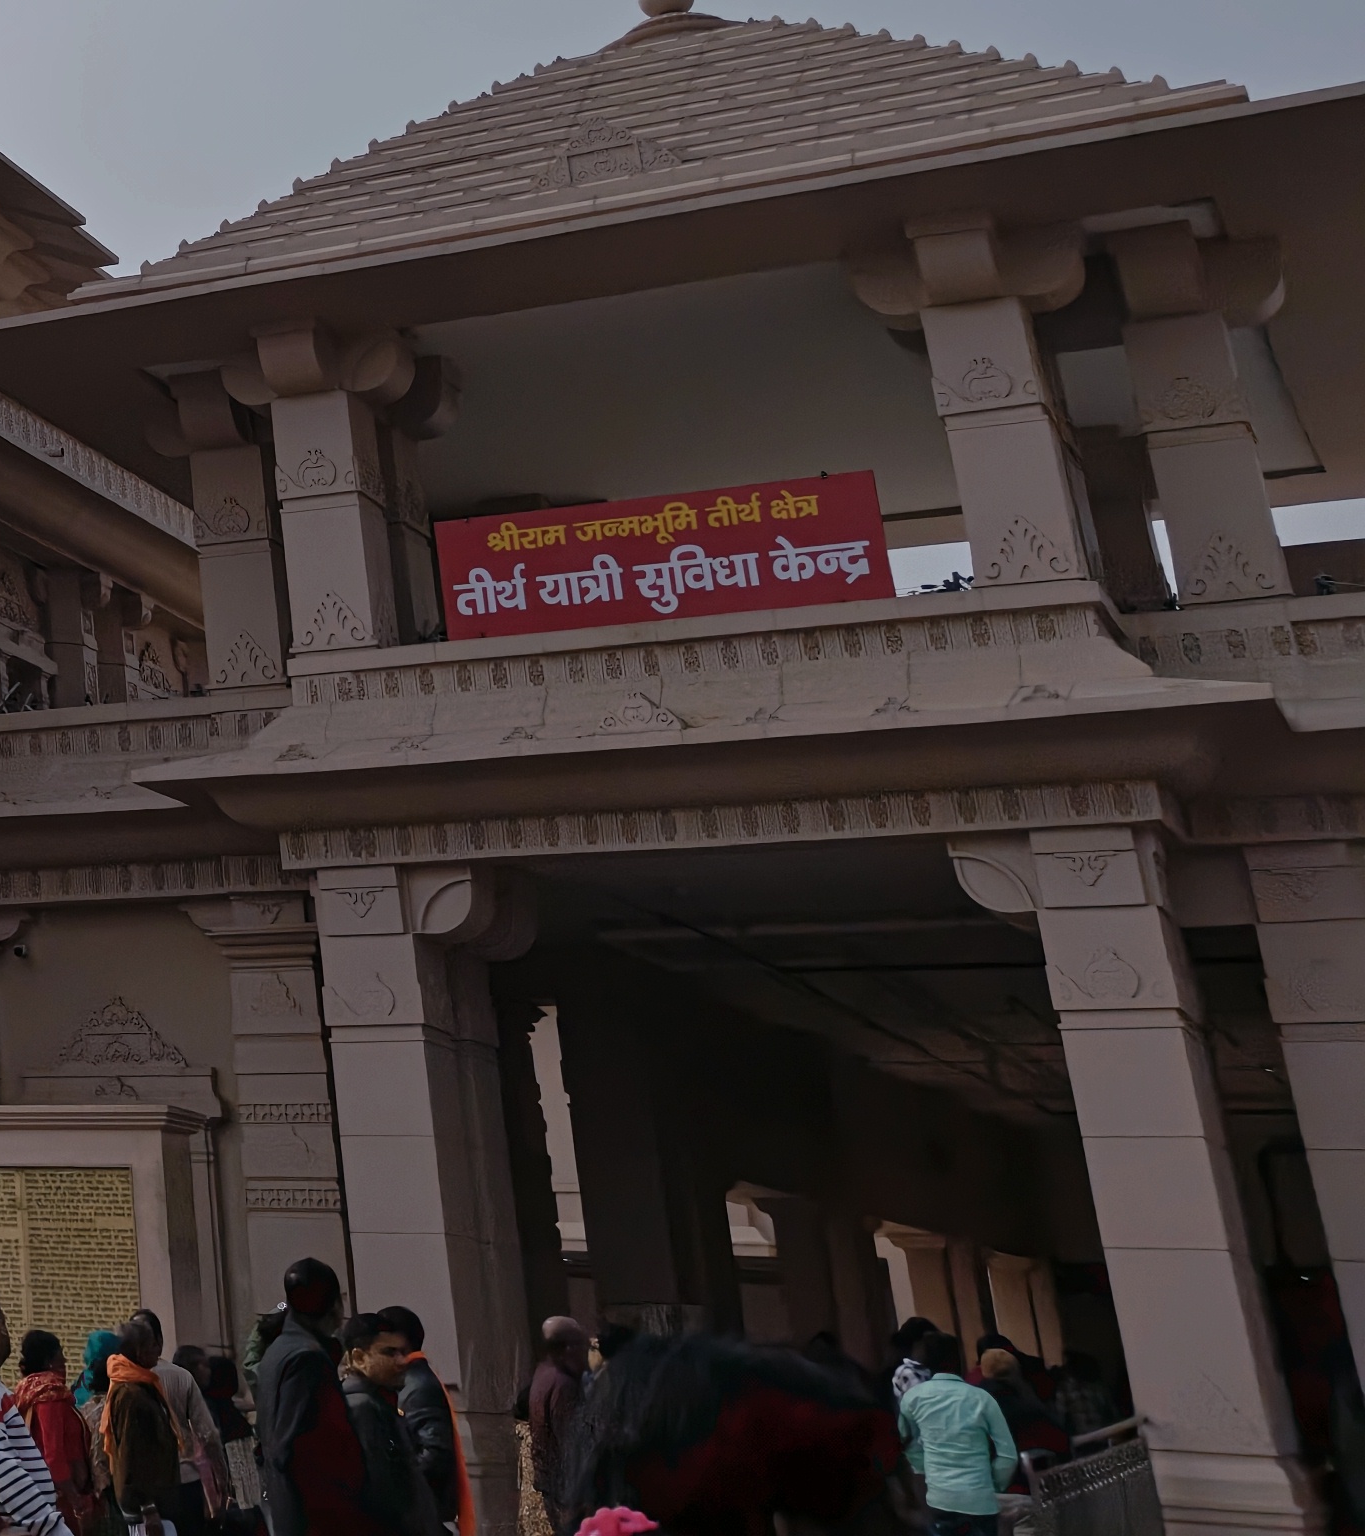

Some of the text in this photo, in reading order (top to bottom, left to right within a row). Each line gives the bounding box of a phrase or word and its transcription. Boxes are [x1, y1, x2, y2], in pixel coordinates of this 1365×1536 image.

[487, 490, 819, 552] श्रीराम जन्मभूमि तीर्थ क्षेत्र
[453, 536, 870, 616] तीर्थ यात्री सुविधा केन्द्र
